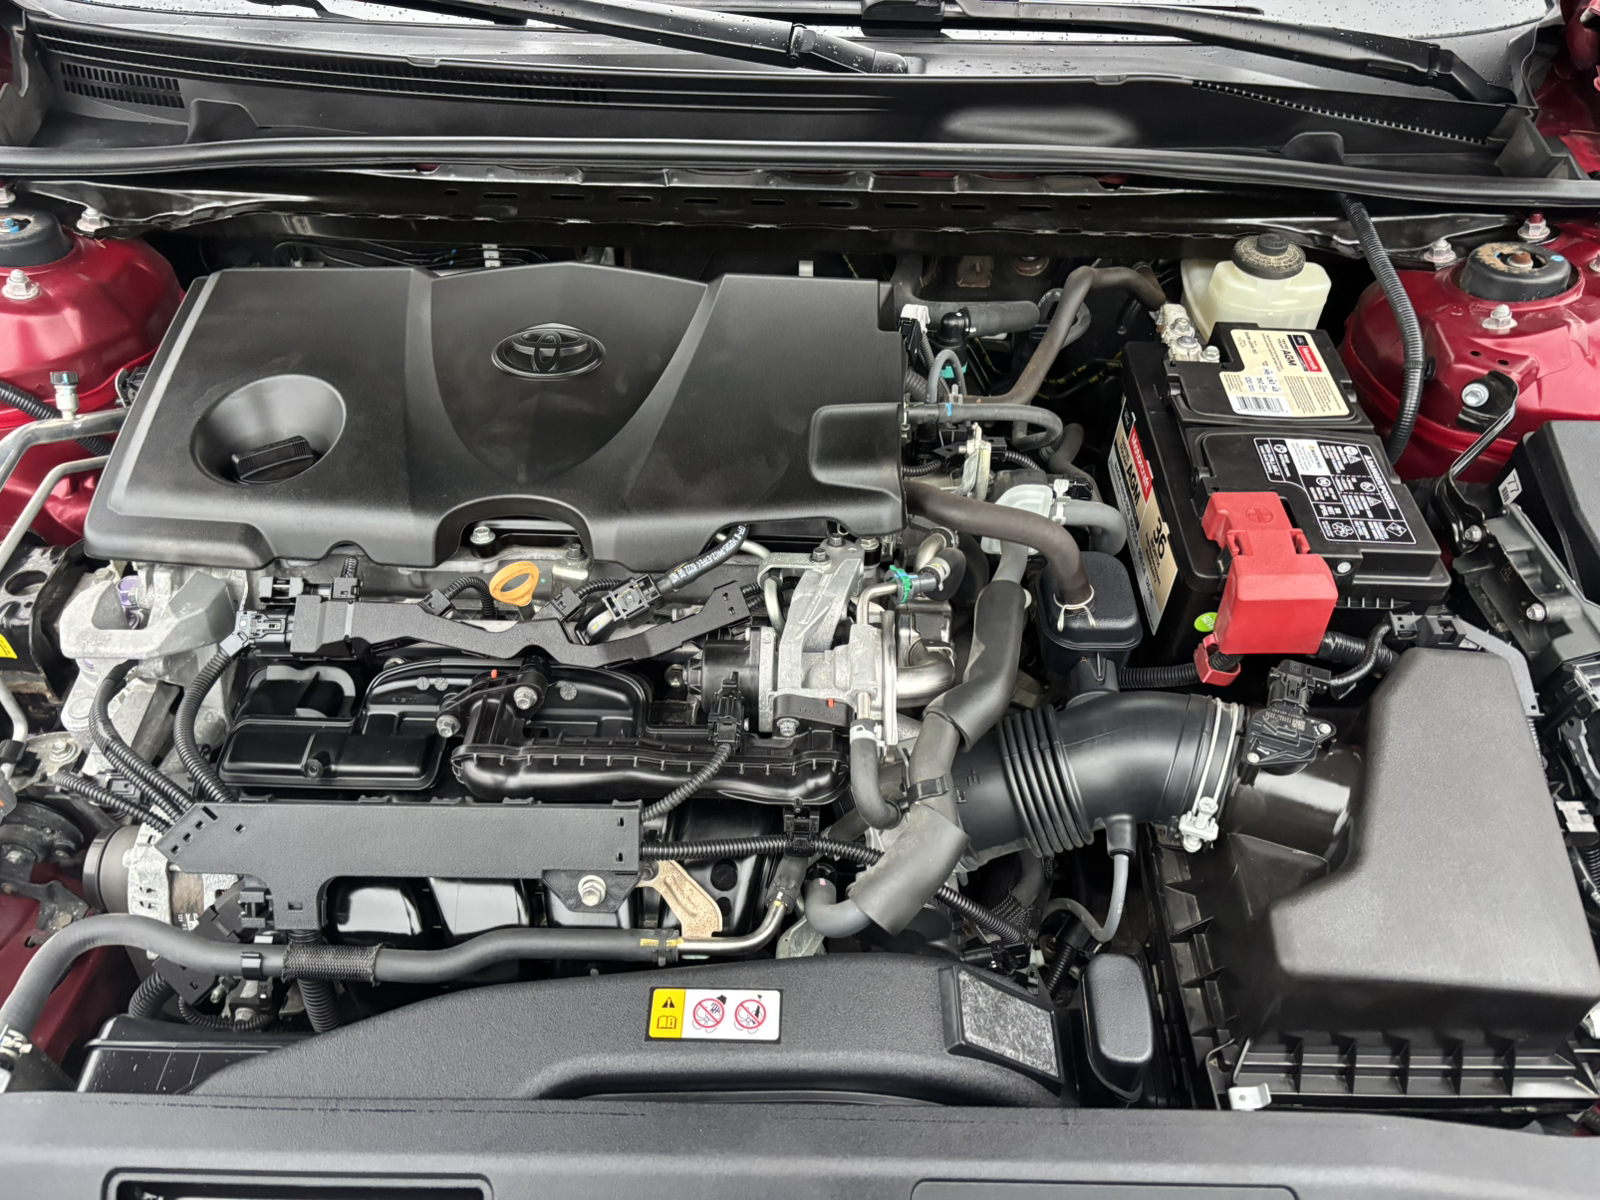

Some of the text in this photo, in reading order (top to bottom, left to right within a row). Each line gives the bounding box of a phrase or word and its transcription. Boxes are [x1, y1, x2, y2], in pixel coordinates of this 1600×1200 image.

[1281, 350, 1297, 366] AGM
[1302, 347, 1318, 370] Motorcraft
[1132, 433, 1149, 493] Motorcraft
[1127, 464, 1140, 507] AGM
[1153, 516, 1167, 560] 36
